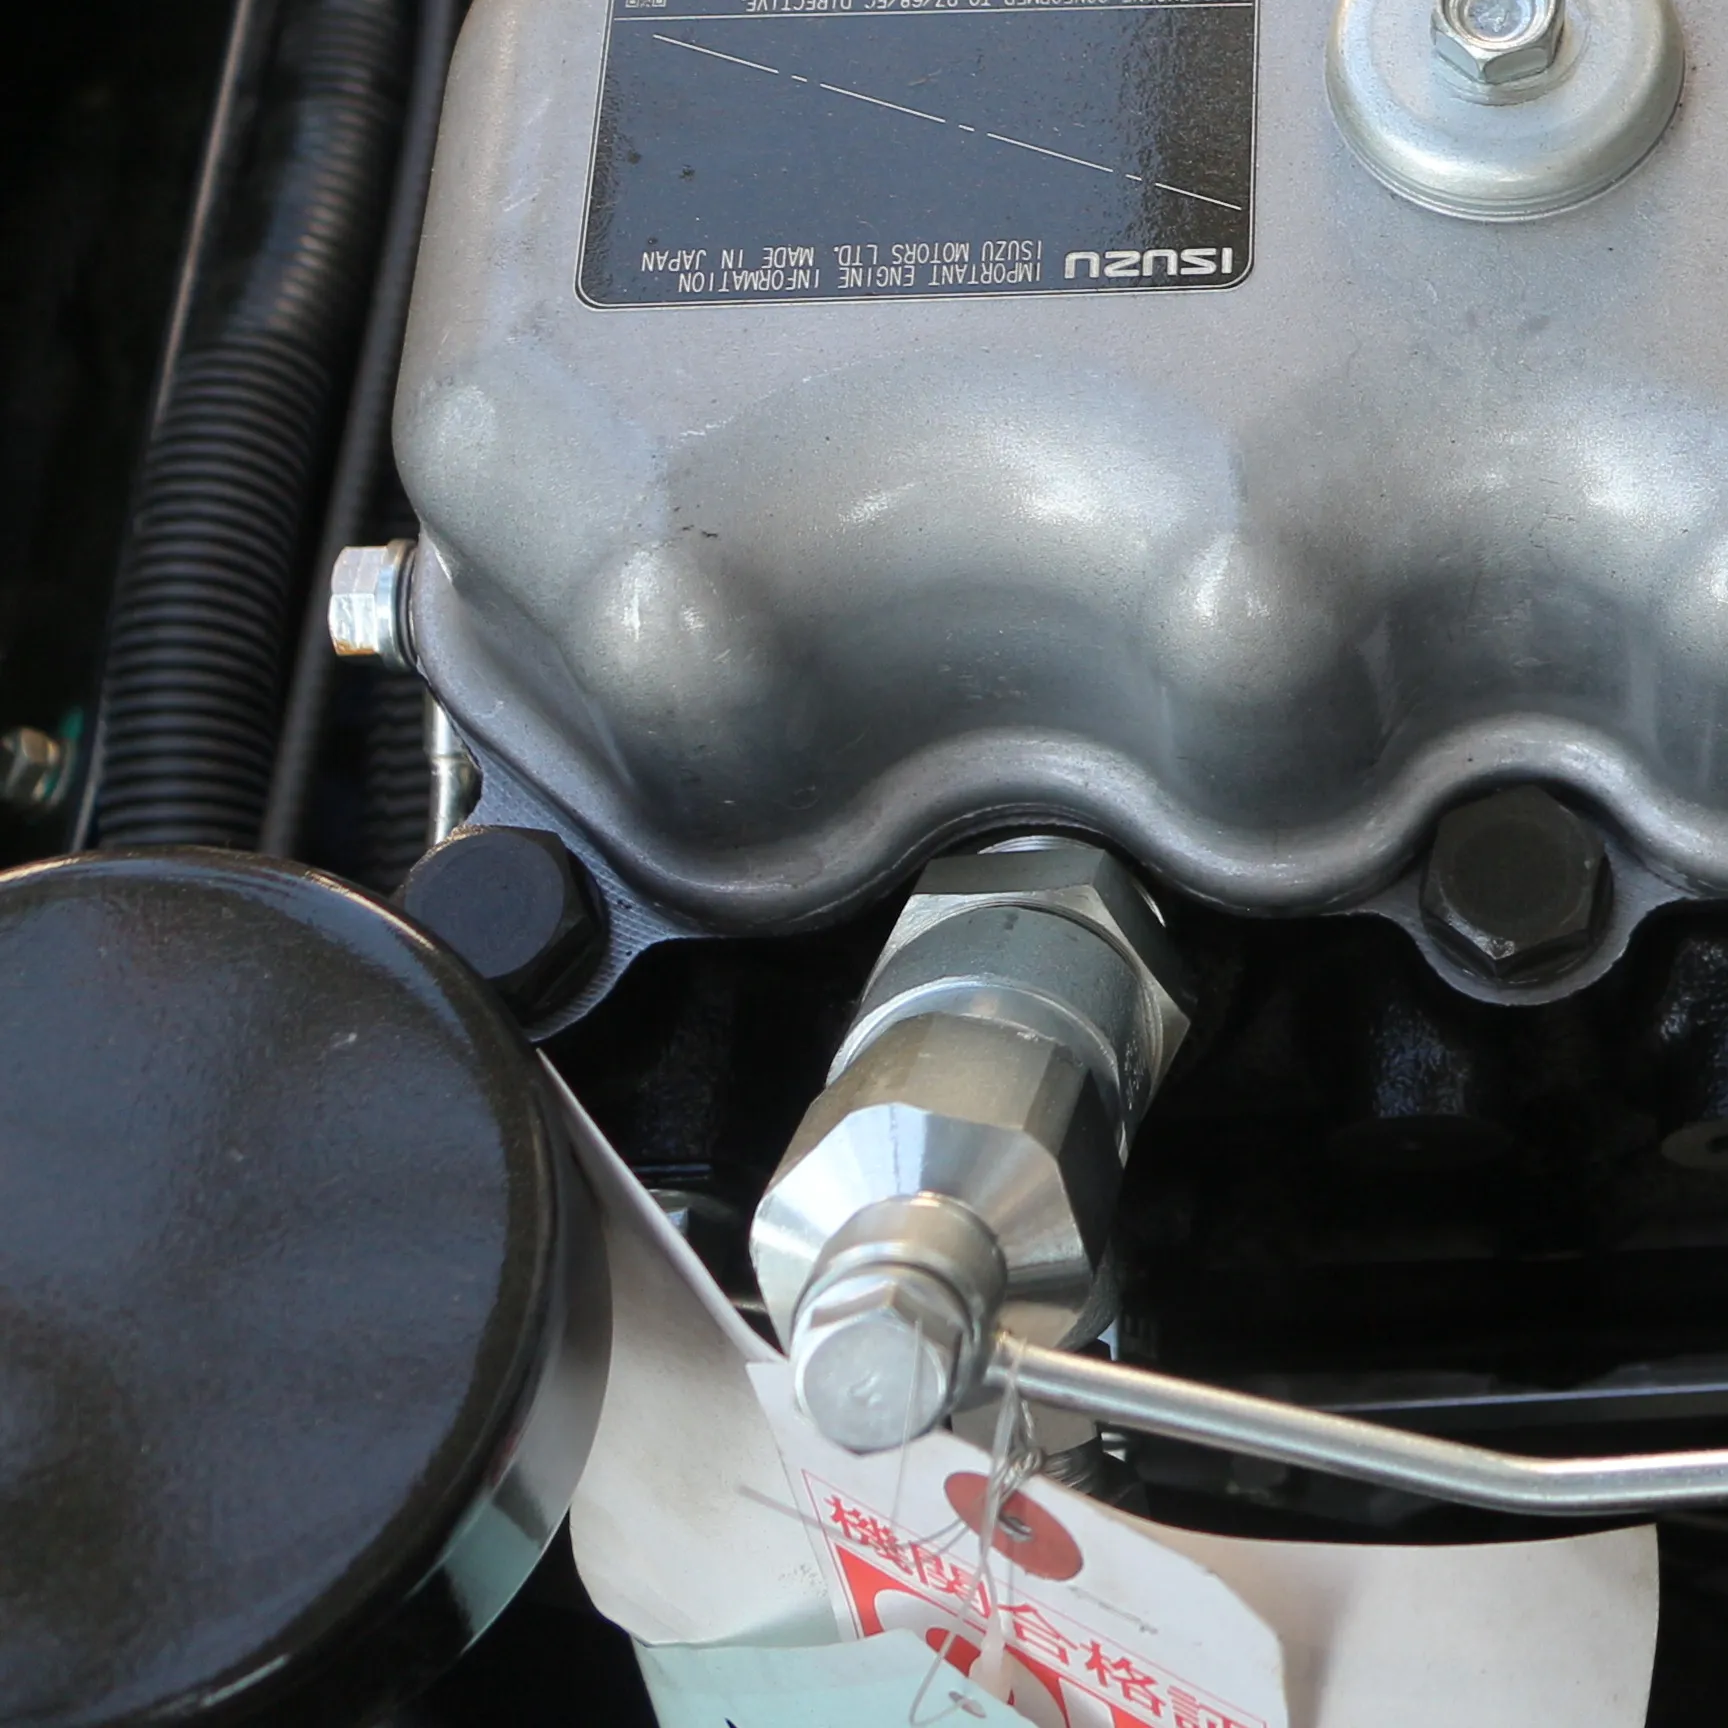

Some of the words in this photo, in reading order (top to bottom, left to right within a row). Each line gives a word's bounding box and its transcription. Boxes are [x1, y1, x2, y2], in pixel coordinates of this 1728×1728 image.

[641, 249, 707, 272] JAPAN
[721, 248, 743, 270] IN
[761, 246, 815, 269] MADE
[833, 244, 878, 267] LTD.
[891, 242, 970, 265] MOTORS
[981, 240, 1042, 261] ISUZU
[928, 262, 1041, 287] IMPORTANT
[1064, 247, 1233, 279] ISUZU
[678, 269, 819, 293] INFORMATION
[838, 265, 914, 289] ENGINE
